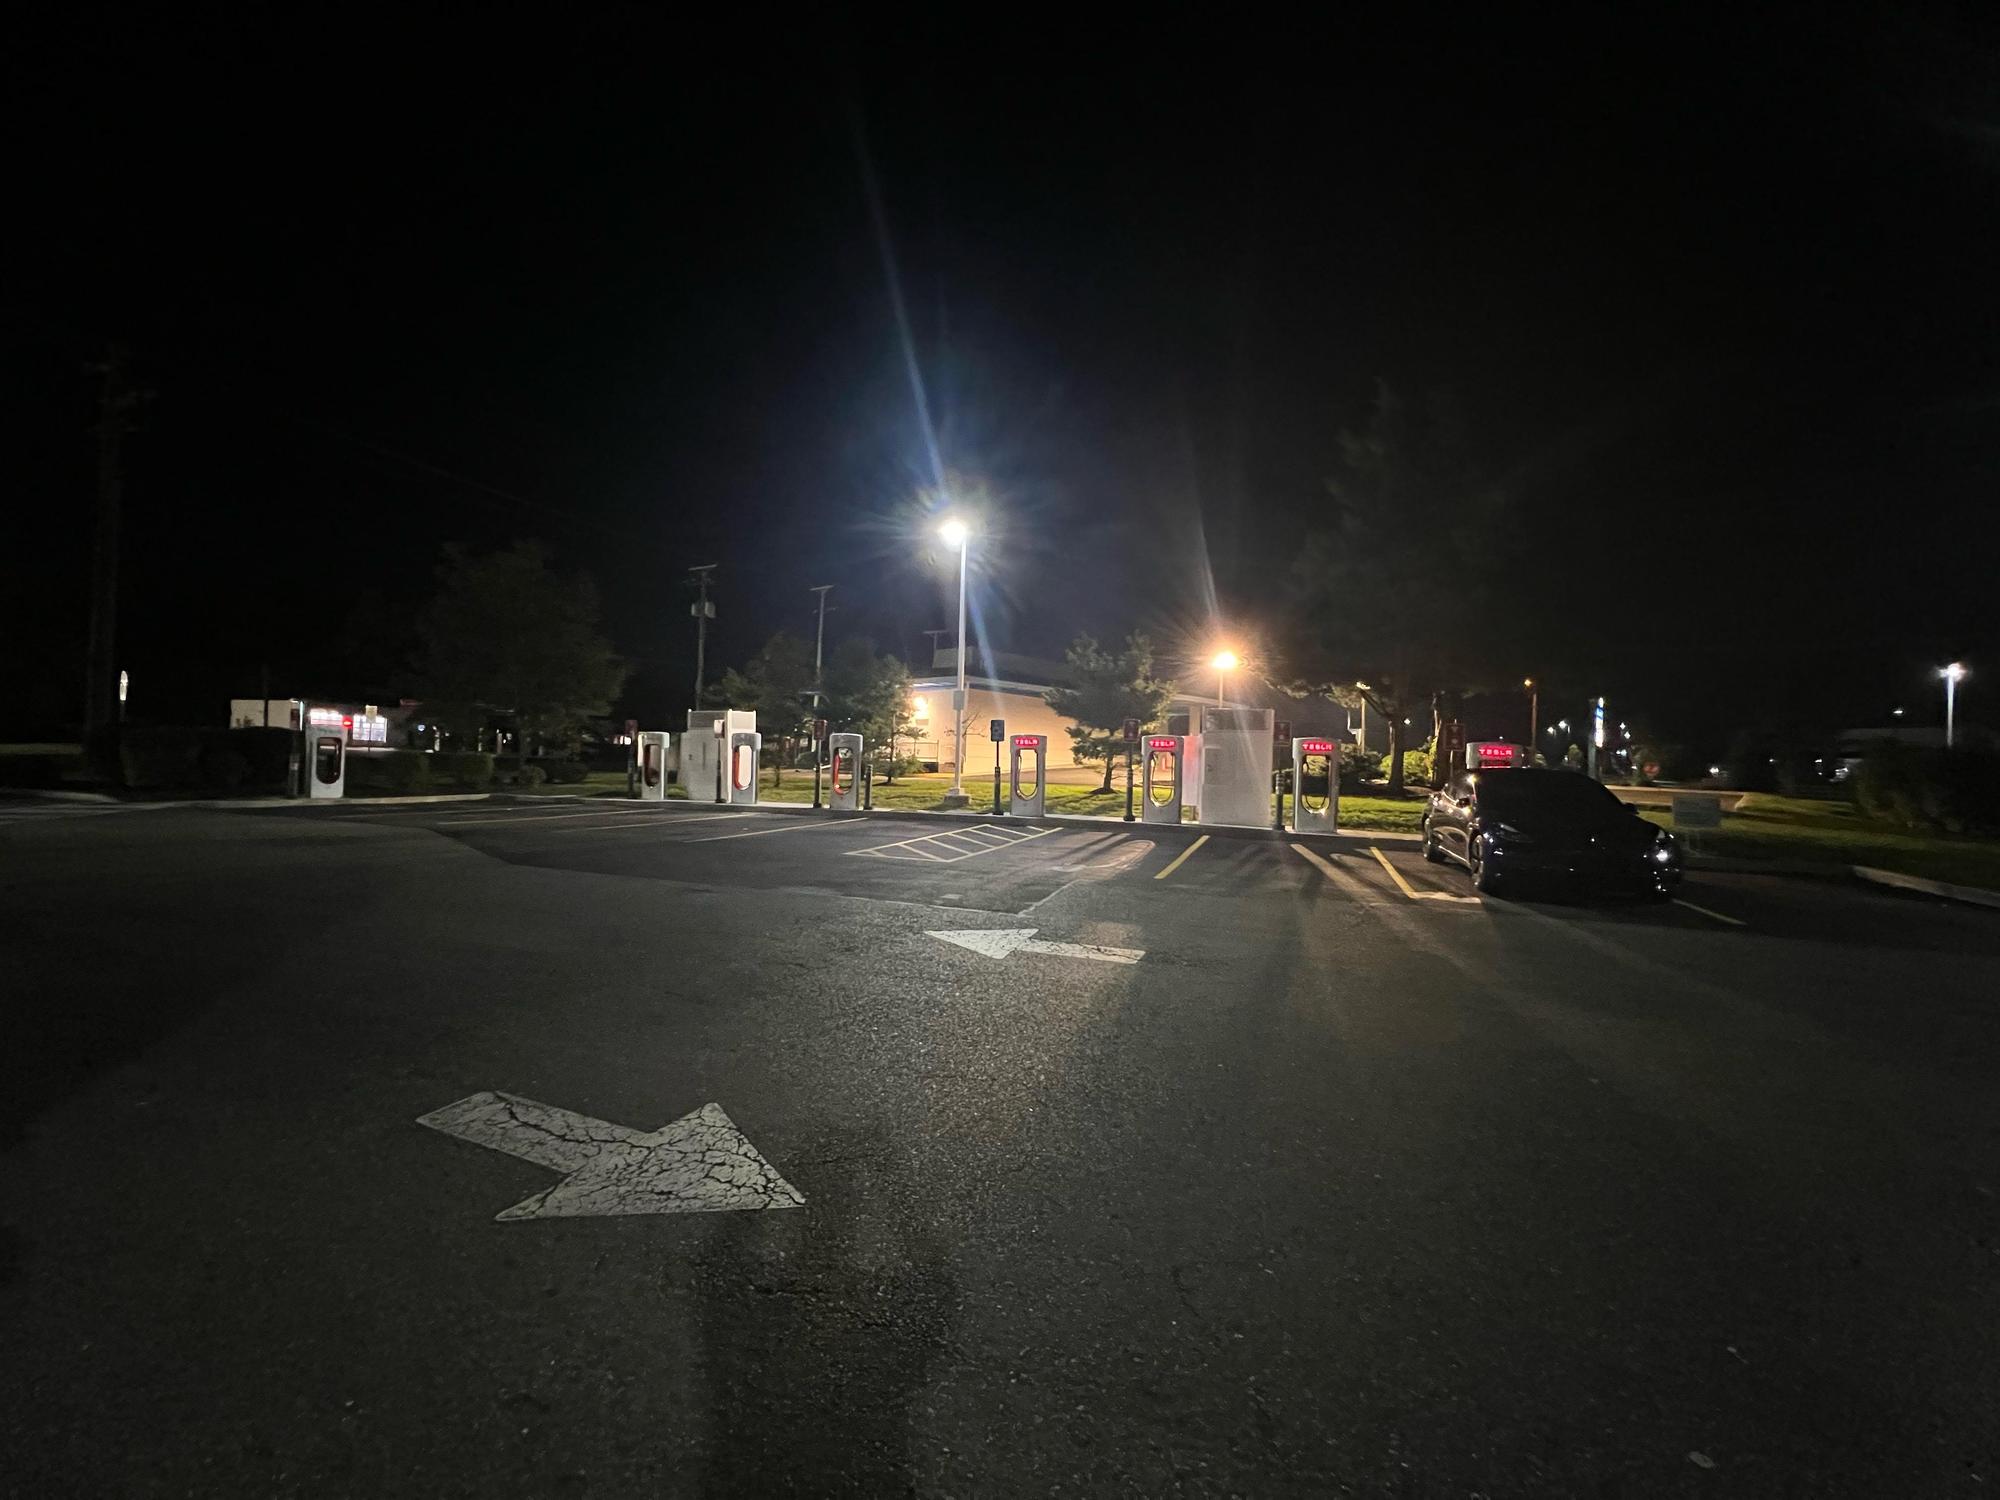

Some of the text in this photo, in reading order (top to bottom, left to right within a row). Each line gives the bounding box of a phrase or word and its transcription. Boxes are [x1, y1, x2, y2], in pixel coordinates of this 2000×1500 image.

[1015, 738, 1038, 746] TESLA
[1302, 743, 1333, 751] TESLA
[1479, 748, 1512, 756] TESLA
